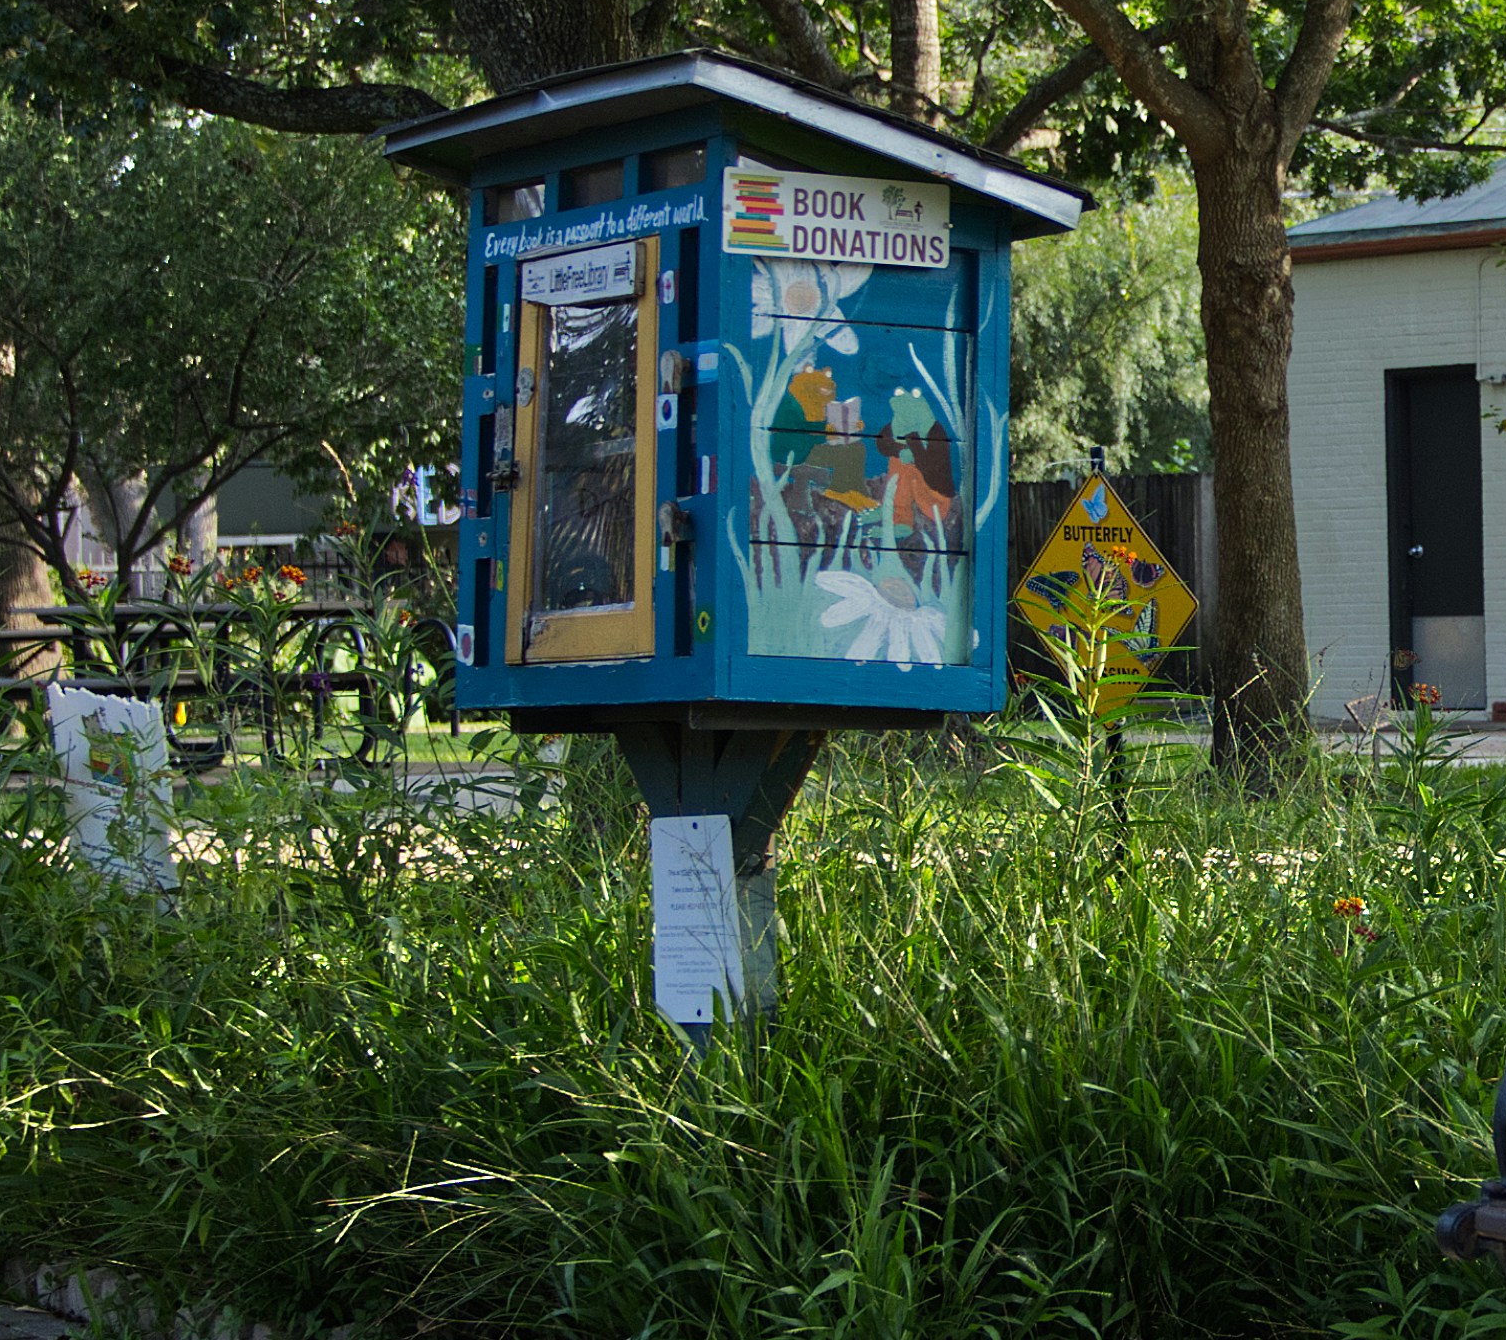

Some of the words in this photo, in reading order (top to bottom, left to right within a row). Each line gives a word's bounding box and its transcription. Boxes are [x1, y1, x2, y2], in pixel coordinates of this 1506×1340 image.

[793, 188, 866, 221] BOOK
[485, 231, 517, 258] Every
[519, 224, 543, 253] book
[545, 226, 556, 247] is
[606, 211, 616, 238] to
[617, 218, 625, 234] a
[626, 201, 671, 231] different
[792, 225, 945, 264] DONATIONS
[1063, 525, 1134, 543] BUTTERFLY
